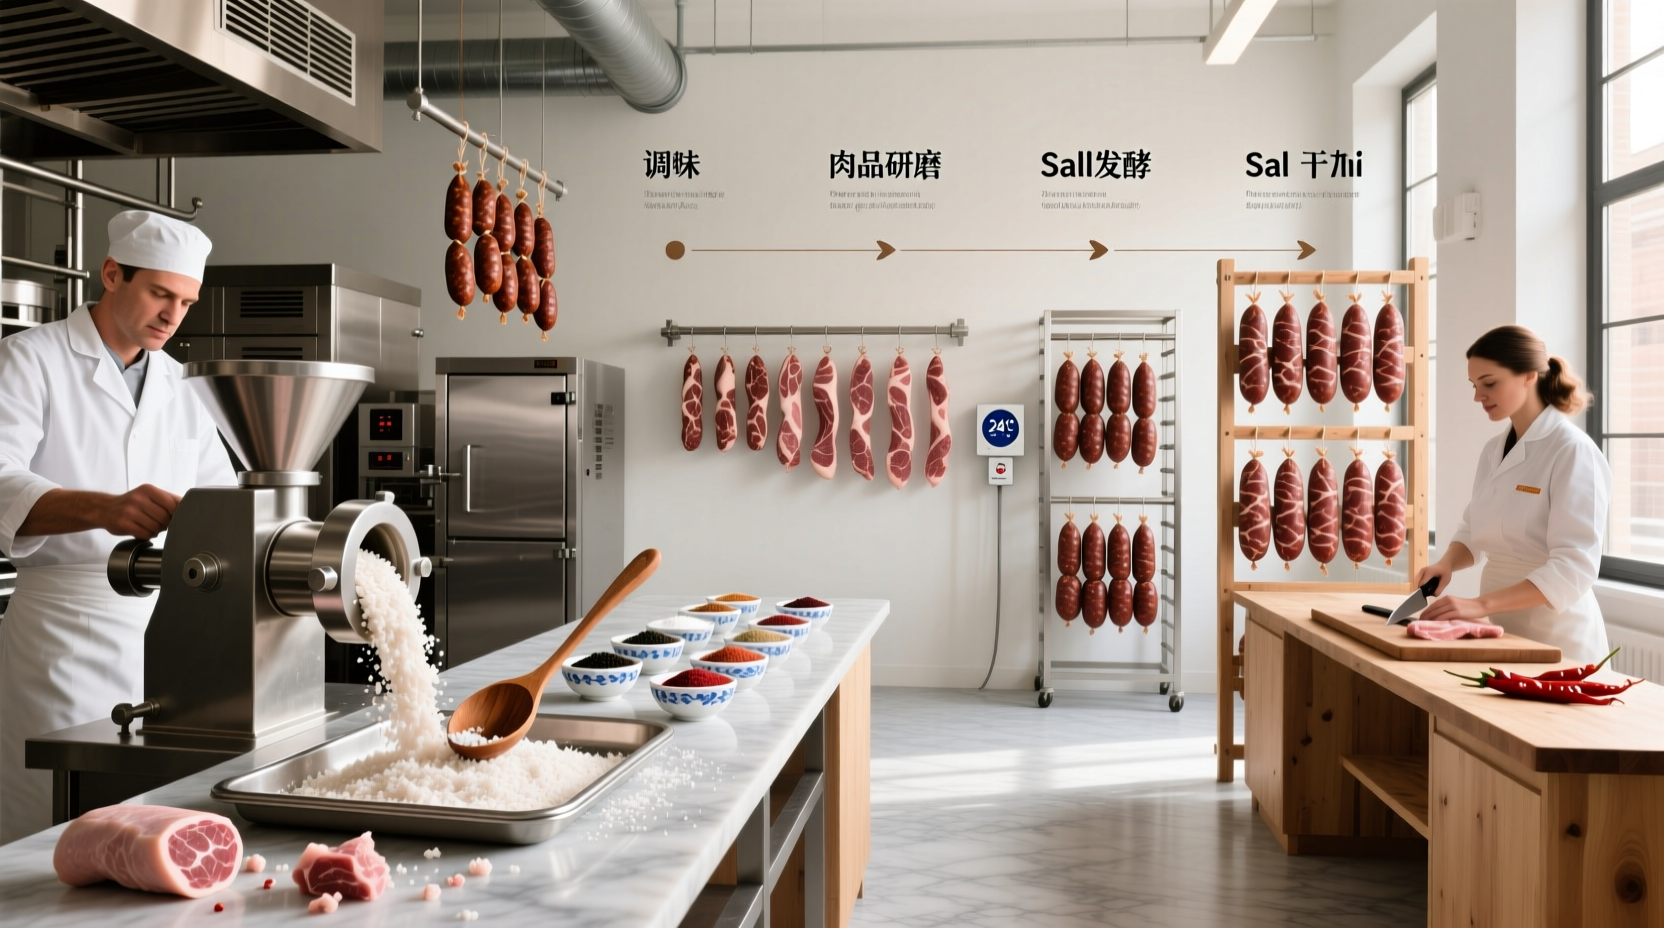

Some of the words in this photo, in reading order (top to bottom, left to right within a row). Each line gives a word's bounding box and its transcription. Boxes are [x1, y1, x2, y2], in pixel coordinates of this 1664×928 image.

[830, 149, 941, 180] 肉品研磨
[1041, 149, 1152, 180] Sall发酵
[1245, 150, 1289, 178] Sal
